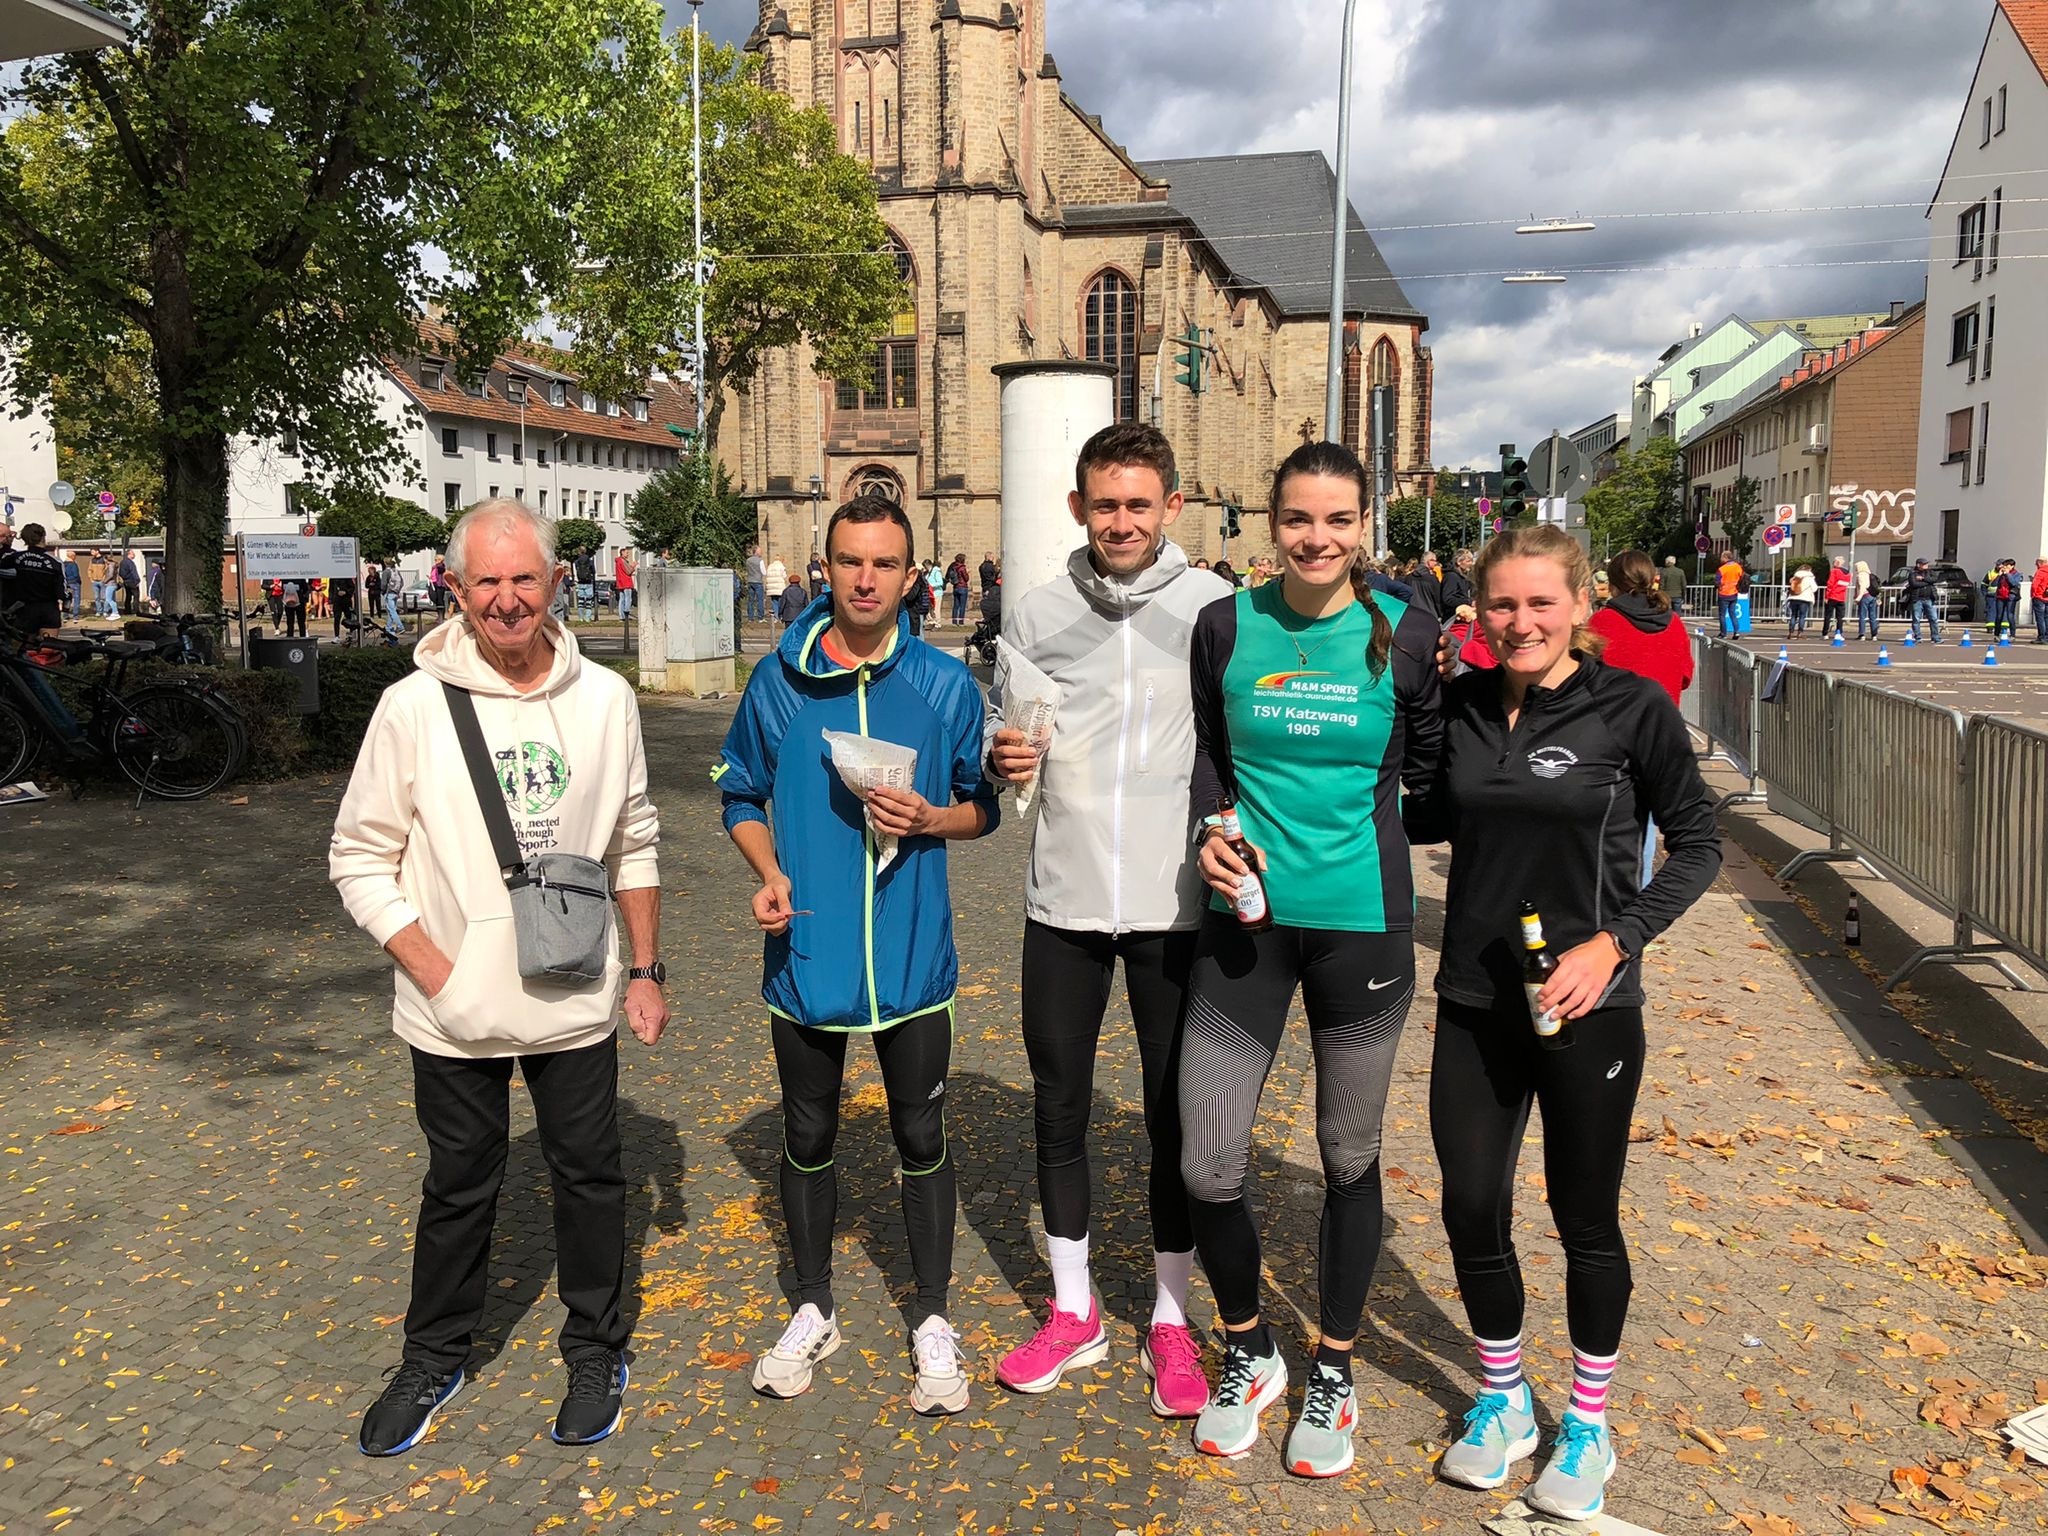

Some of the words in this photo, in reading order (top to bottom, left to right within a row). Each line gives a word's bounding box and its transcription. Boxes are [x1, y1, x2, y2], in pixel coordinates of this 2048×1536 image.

[247, 552, 256, 560] für
[256, 552, 280, 560] Wirtschaft
[281, 552, 310, 560] Saarbrücken
[1291, 681, 1318, 692] M&M
[1320, 682, 1359, 695] SPORTS
[1253, 689, 1358, 703] leichtathletik-ausruester.de
[1252, 705, 1282, 718] TSV
[1285, 707, 1358, 727] Katzwang
[1286, 722, 1320, 736] 1905
